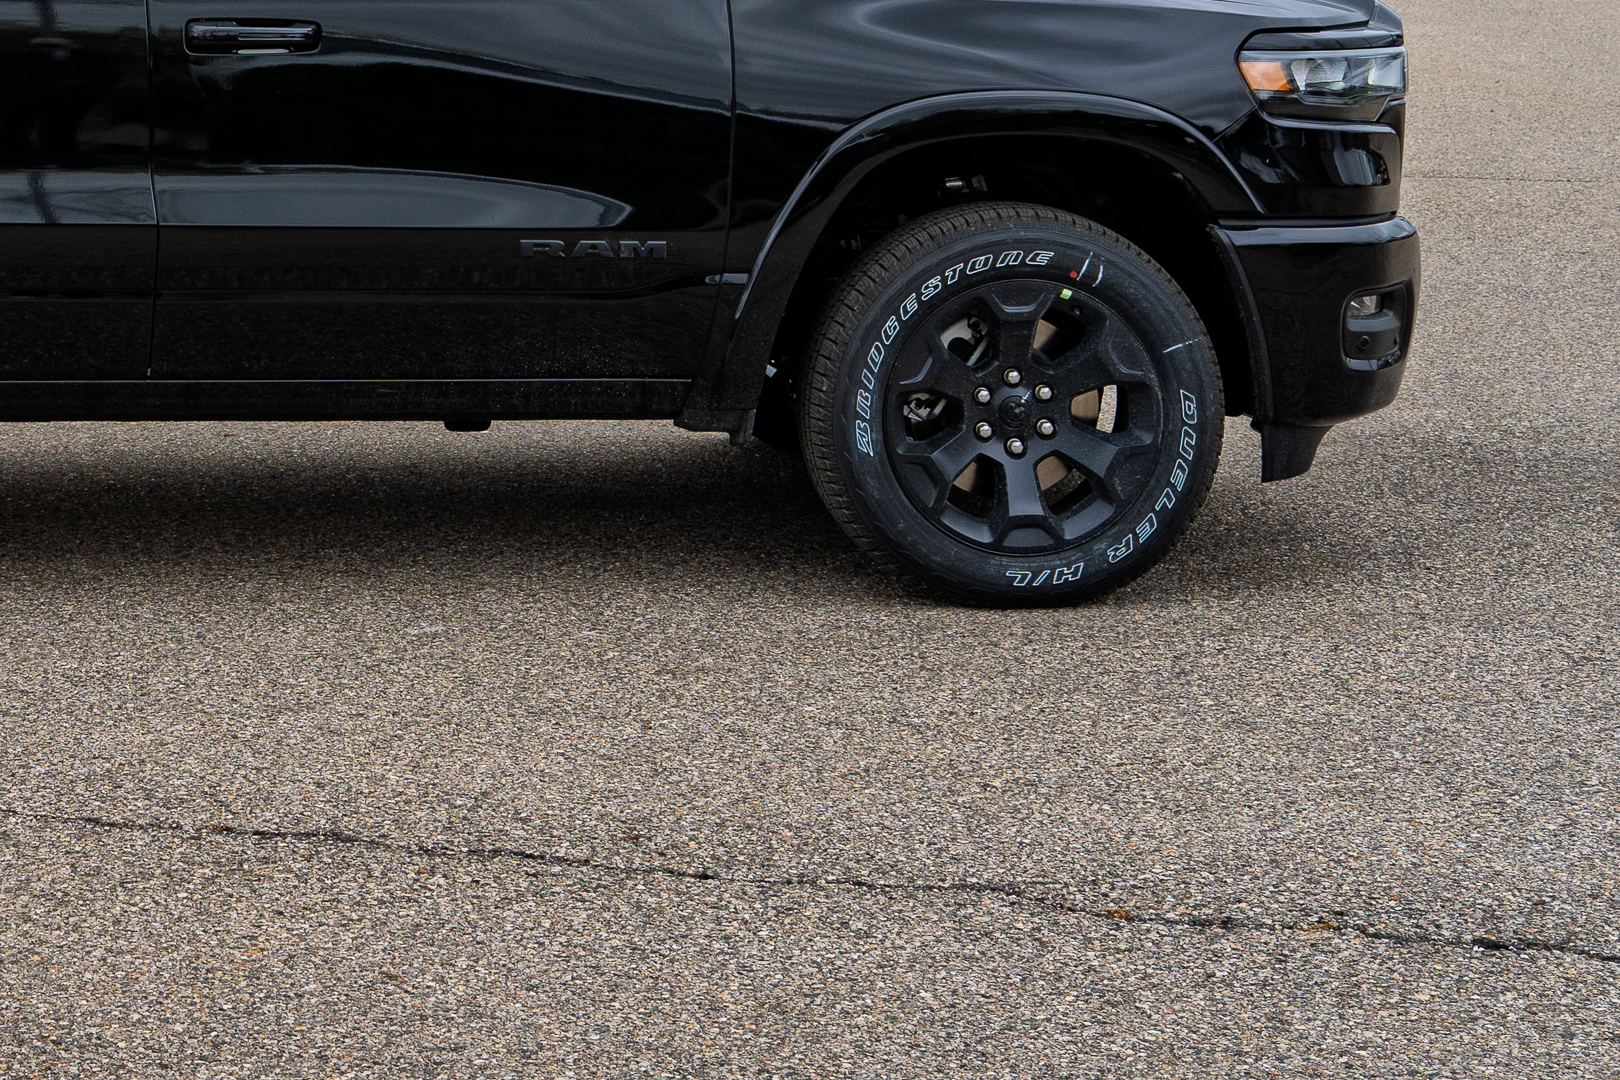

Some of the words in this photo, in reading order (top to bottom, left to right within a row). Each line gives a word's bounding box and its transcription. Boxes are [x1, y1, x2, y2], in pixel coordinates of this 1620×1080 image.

[520, 239, 667, 258] RAM
[855, 250, 1055, 457] BRIDGESTONE
[1107, 389, 1197, 564] DUELER
[1006, 562, 1084, 587] H/L
